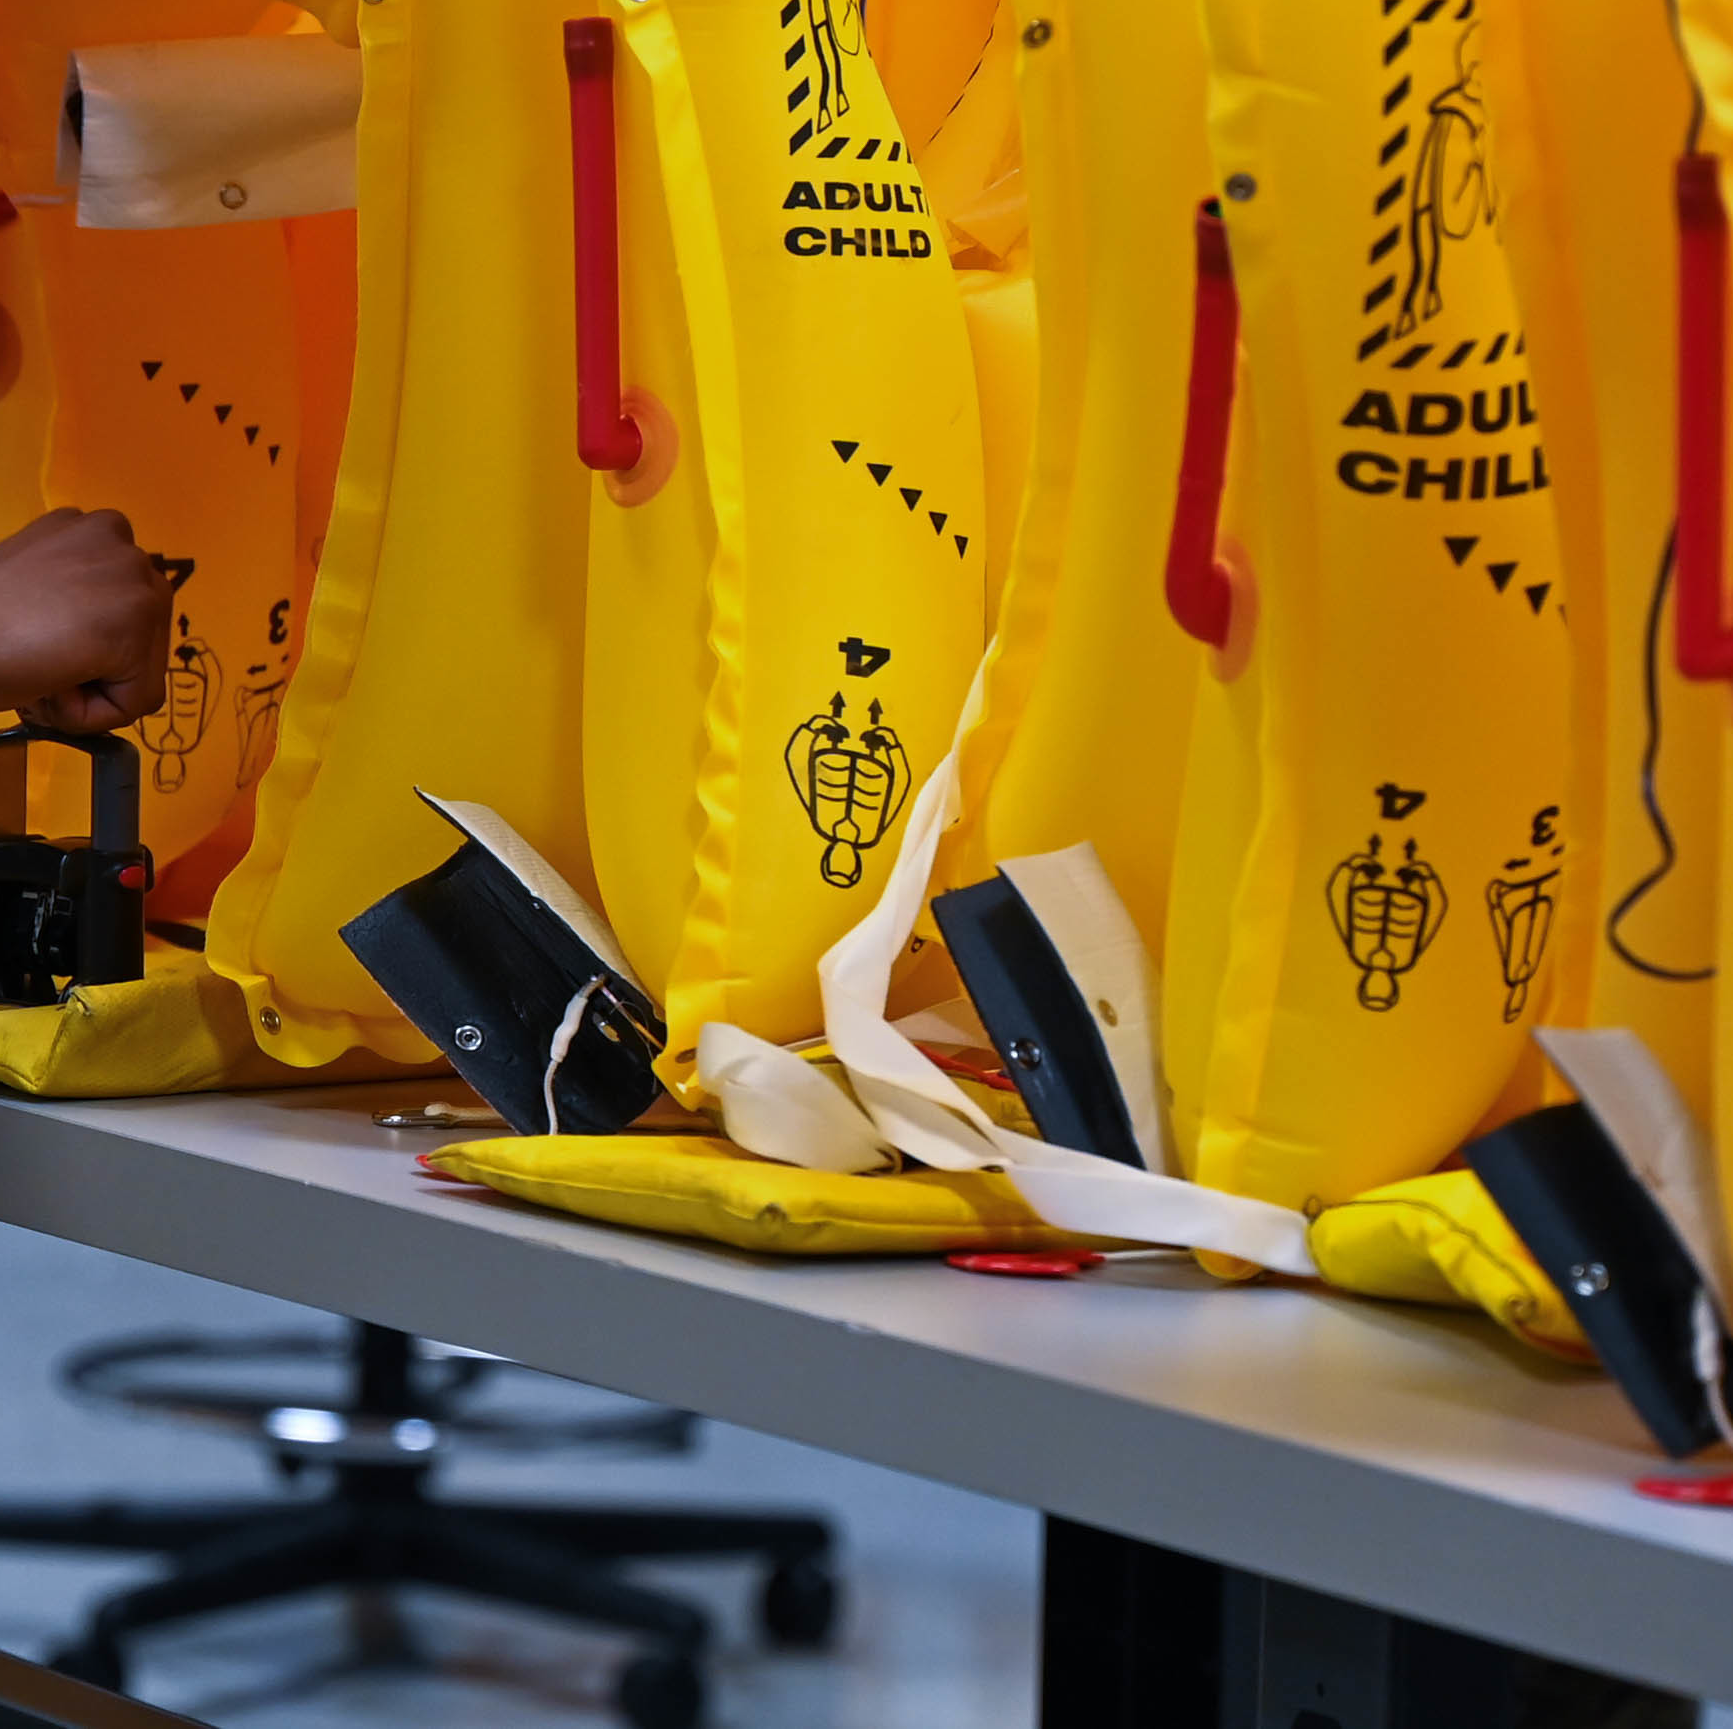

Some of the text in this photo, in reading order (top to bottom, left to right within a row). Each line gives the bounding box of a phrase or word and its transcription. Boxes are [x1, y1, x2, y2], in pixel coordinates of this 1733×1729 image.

[784, 226, 932, 259] CHILD
[1340, 380, 1538, 438] ADUL
[838, 636, 892, 679] 4
[1375, 781, 1427, 821] 4
[1530, 805, 1561, 847] 3
